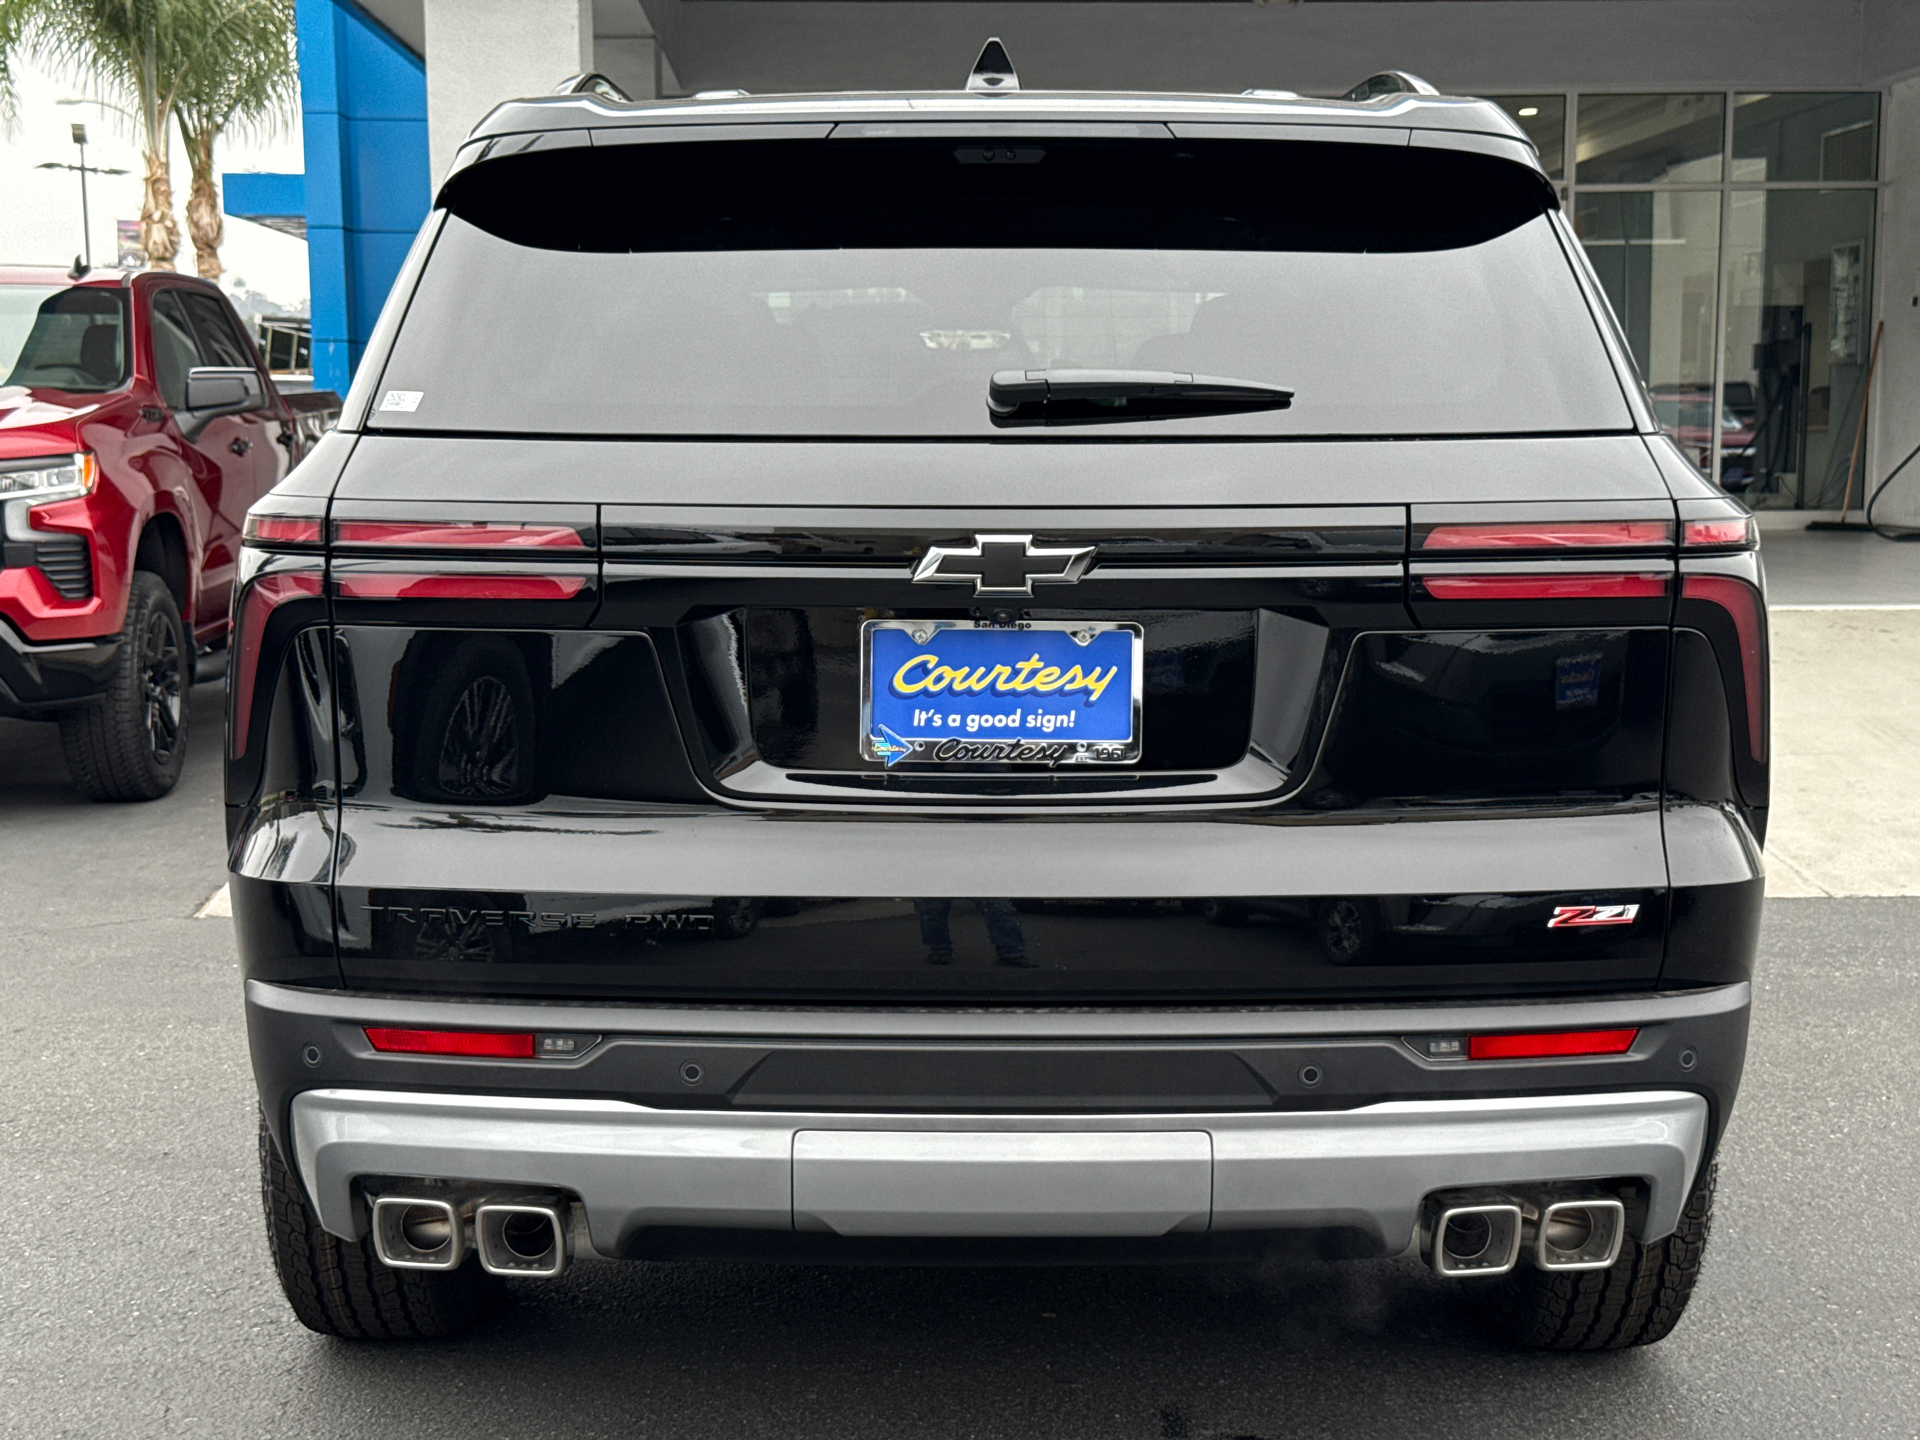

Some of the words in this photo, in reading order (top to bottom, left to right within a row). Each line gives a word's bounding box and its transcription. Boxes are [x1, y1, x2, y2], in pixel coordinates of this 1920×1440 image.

[974, 620, 995, 629] San
[999, 621, 1032, 631] Diego
[892, 653, 1118, 703] Courtesy
[947, 714, 961, 727] a
[966, 708, 1022, 732] good
[1026, 708, 1076, 733] sign!
[934, 737, 1068, 767] Courtesy
[1094, 746, 1126, 761] 1961
[360, 905, 597, 930] TRAVERSE
